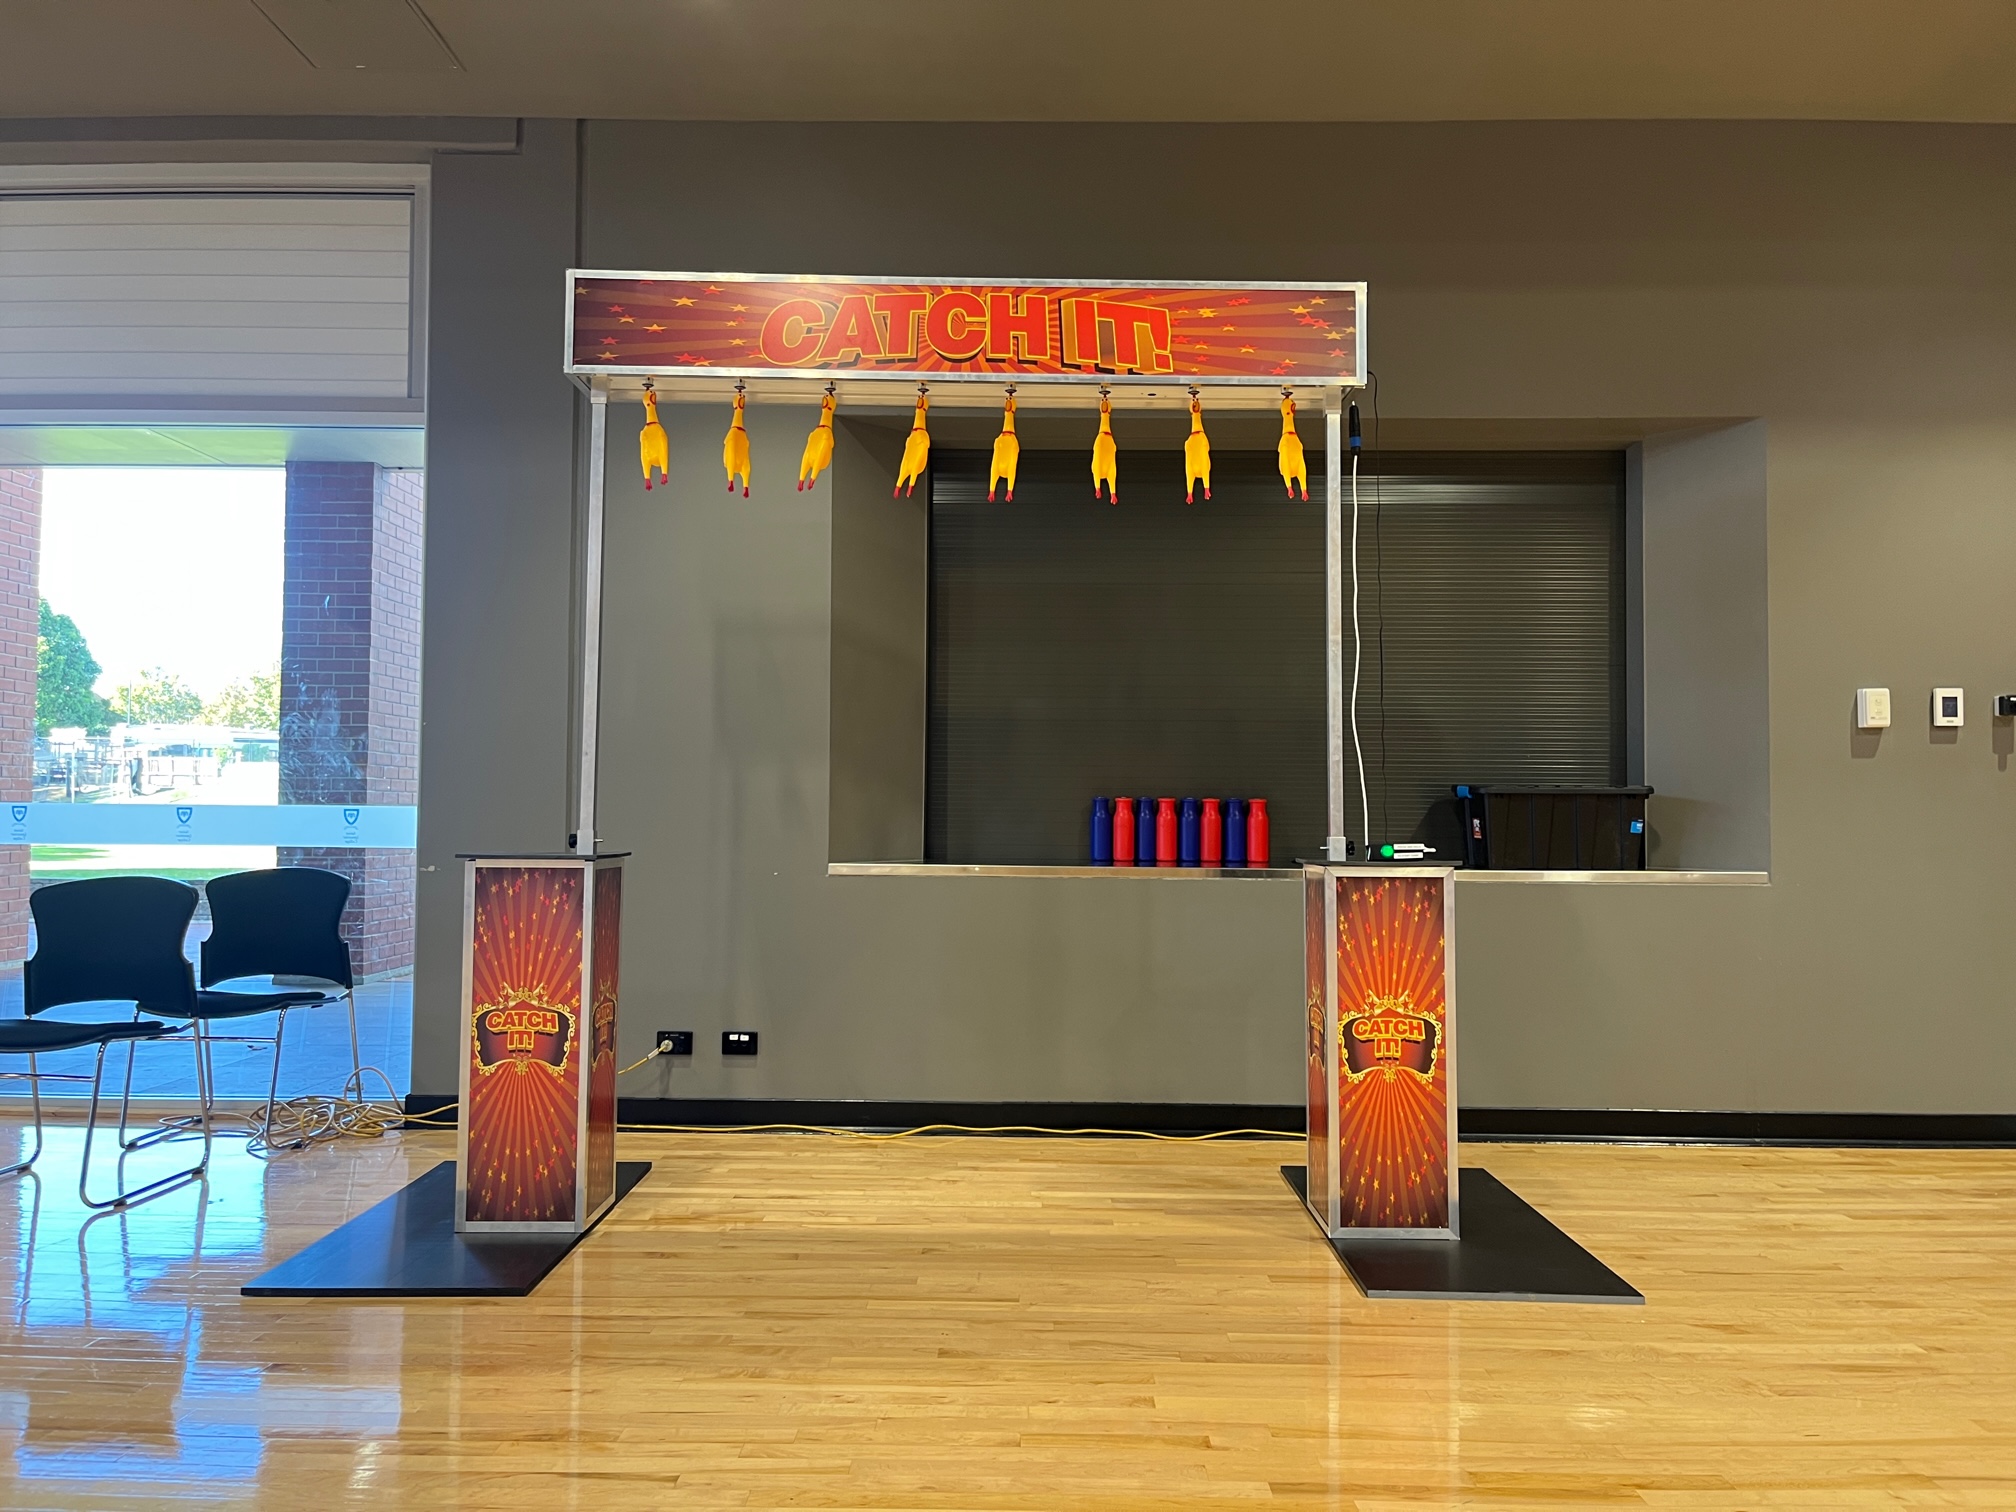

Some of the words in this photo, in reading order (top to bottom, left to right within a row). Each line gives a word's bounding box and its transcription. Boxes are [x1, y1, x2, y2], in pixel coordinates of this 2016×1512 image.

[760, 291, 1050, 367] CATCH
[1062, 298, 1173, 373] IT!
[486, 1010, 559, 1033] CATCH
[1352, 1018, 1426, 1040] CATCH
[507, 1030, 534, 1051] IT!
